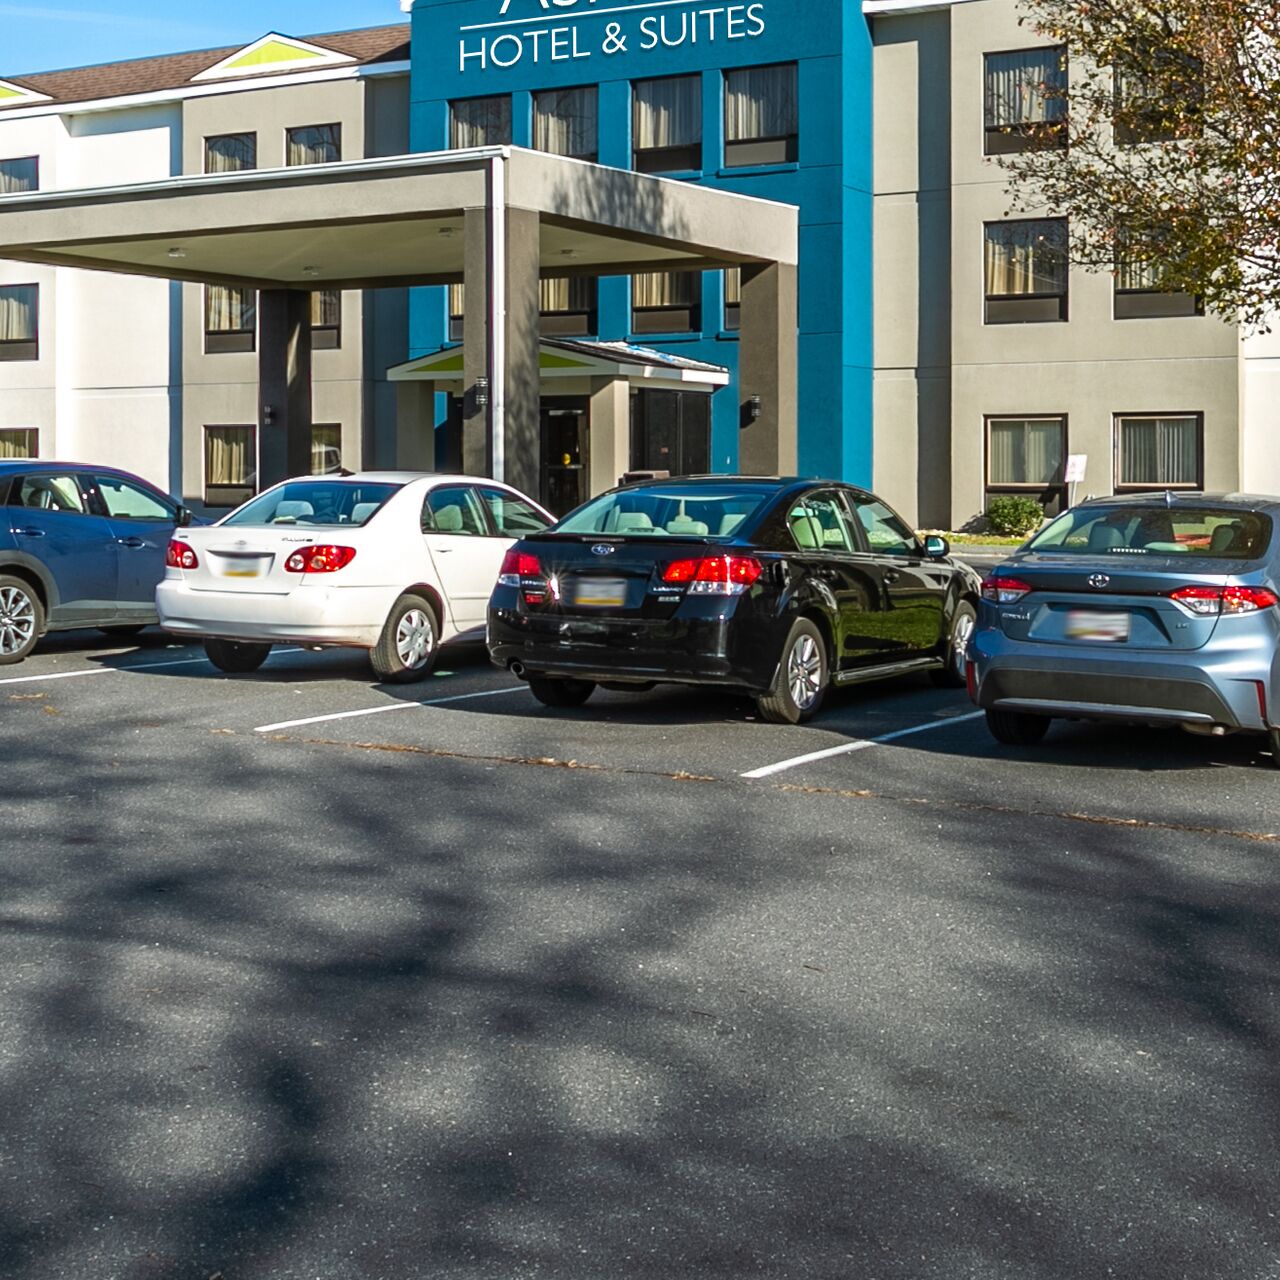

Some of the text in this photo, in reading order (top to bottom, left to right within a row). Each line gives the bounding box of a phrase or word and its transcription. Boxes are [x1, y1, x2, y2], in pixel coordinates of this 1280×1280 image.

[459, 3, 765, 72] HOTEL & SUITES
